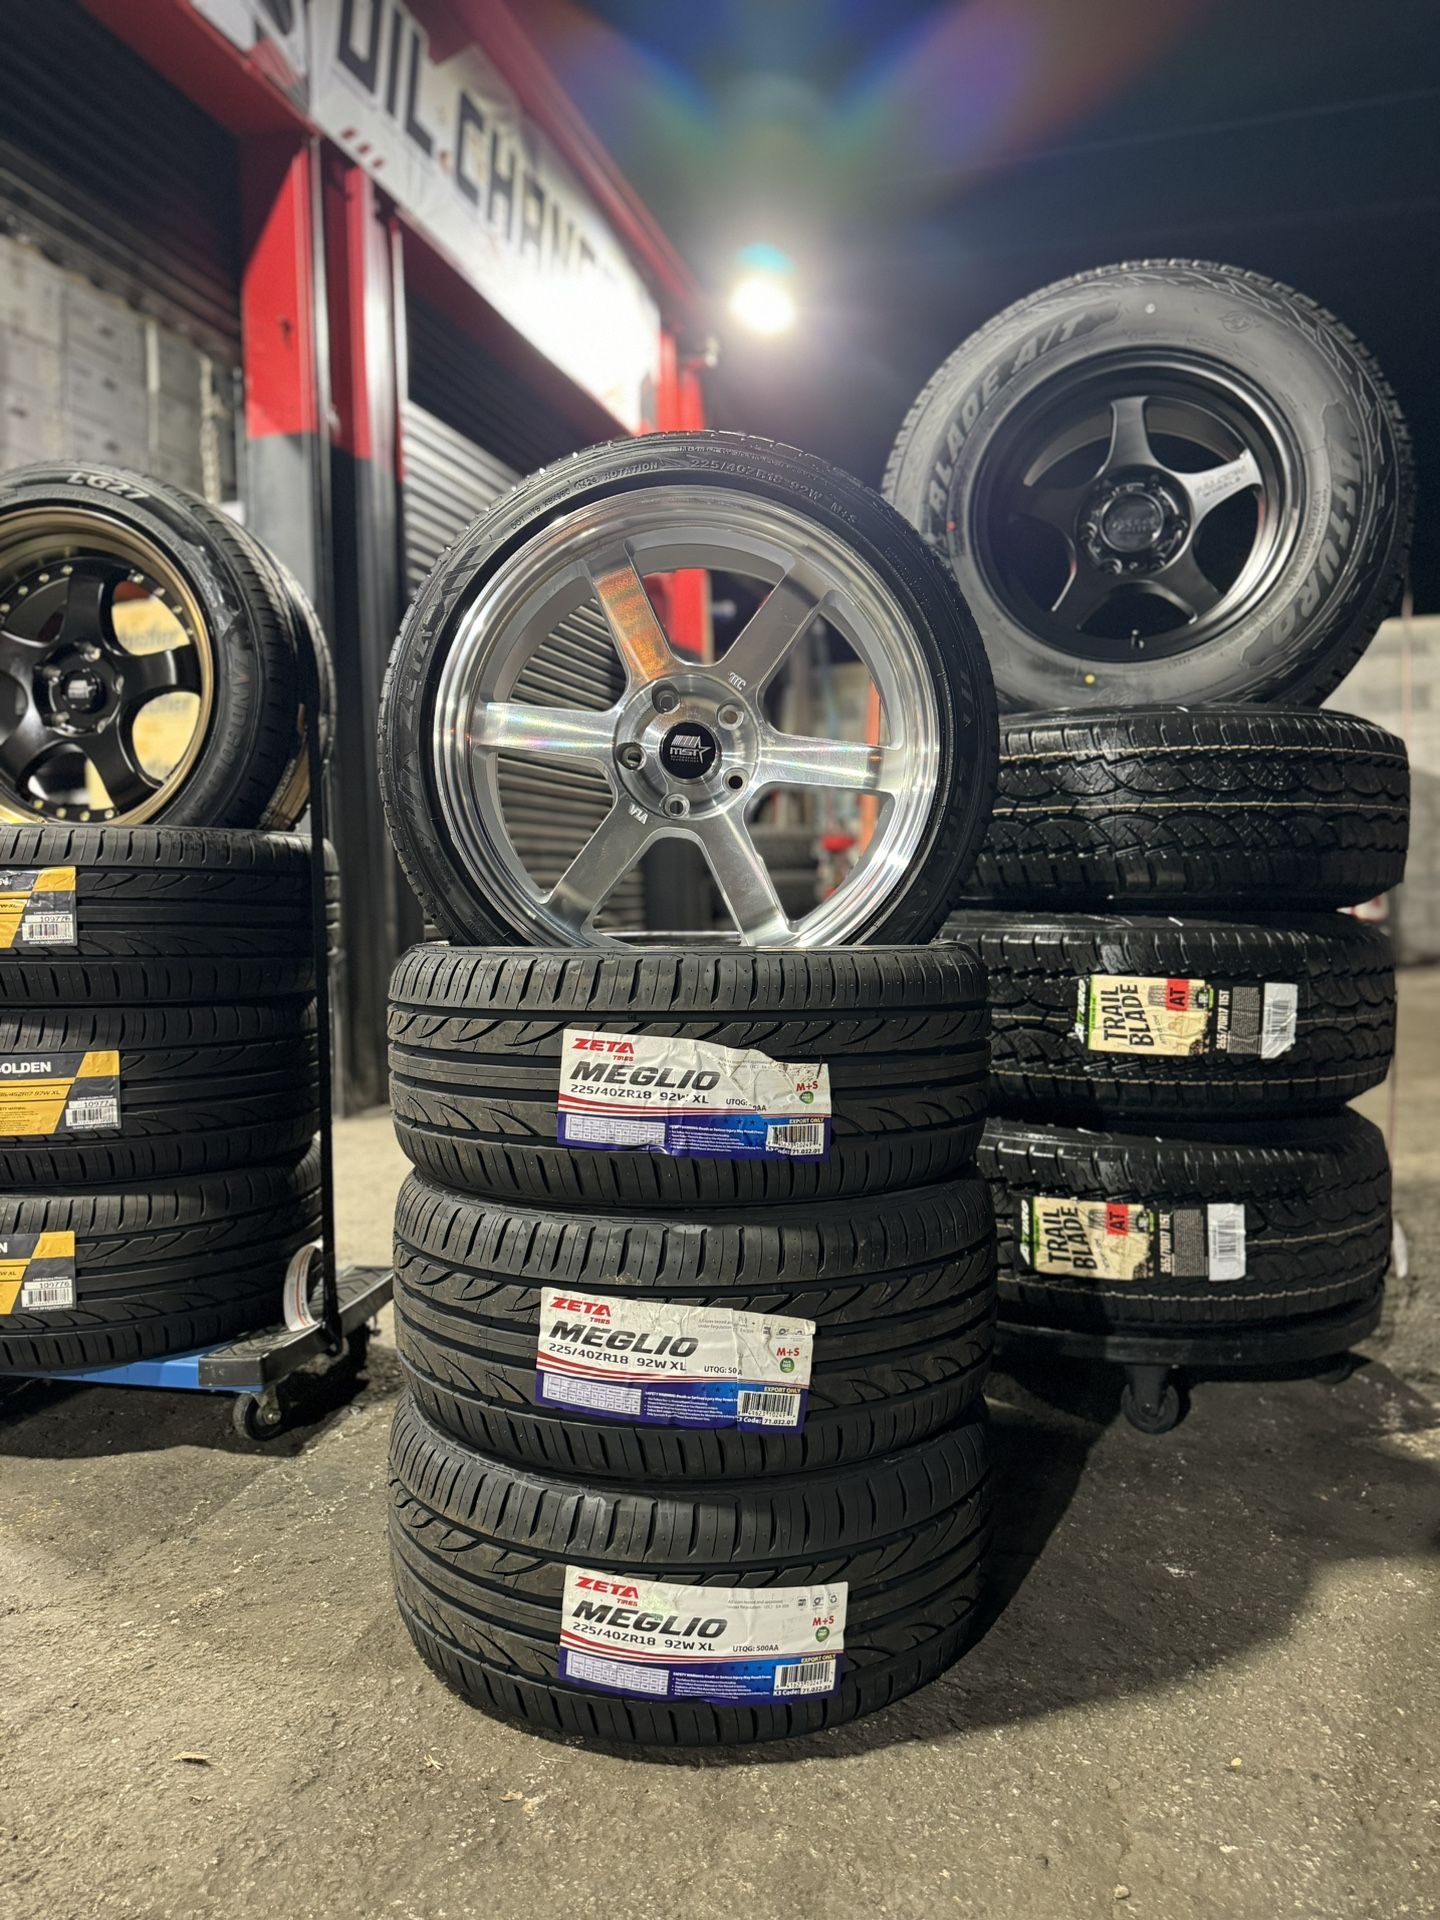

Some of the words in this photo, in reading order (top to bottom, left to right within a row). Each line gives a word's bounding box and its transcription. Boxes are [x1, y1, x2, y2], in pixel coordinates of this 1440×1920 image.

[1011, 312, 1088, 375] A/T
[603, 462, 659, 481] ROTATION
[67, 471, 149, 500] LG27
[670, 746, 701, 756] MST
[1169, 987, 1185, 1006] AT
[1100, 986, 1128, 1041] TRAIL
[1120, 984, 1155, 1047] BLADE
[572, 1037, 635, 1055] ZETA
[0, 1061, 52, 1074] OLDEN
[570, 1061, 721, 1091] MEGLIO
[570, 1084, 652, 1100] 225/40ZR18
[692, 1094, 709, 1105] XL
[796, 1081, 819, 1093] M+S
[1109, 1212, 1125, 1231] AT
[1042, 1208, 1066, 1264] TRAIL
[1061, 1207, 1099, 1270] BLADE
[550, 1296, 611, 1318] ZETA
[590, 1316, 611, 1325] TIRES
[549, 1320, 699, 1358] MEGLIO
[549, 1342, 629, 1365] 225/40ZR18
[637, 1358, 668, 1371] 92W
[669, 1360, 687, 1372] XL
[776, 1347, 800, 1357] M+S
[704, 1366, 727, 1375] UTQG:
[744, 1417, 762, 1425] Code:
[574, 1575, 639, 1599] ZETA
[617, 1598, 639, 1607] TIRES
[572, 1600, 728, 1639] MEGLIO
[812, 1615, 835, 1627] M+S
[573, 1622, 656, 1646] 225/40ZR18
[664, 1639, 695, 1651] 92W
[698, 1641, 716, 1652] XL
[733, 1645, 755, 1653] UTQG:
[756, 1644, 779, 1652] 500AA
[801, 1655, 822, 1663] EXPORT
[782, 1689, 799, 1697] Code:
